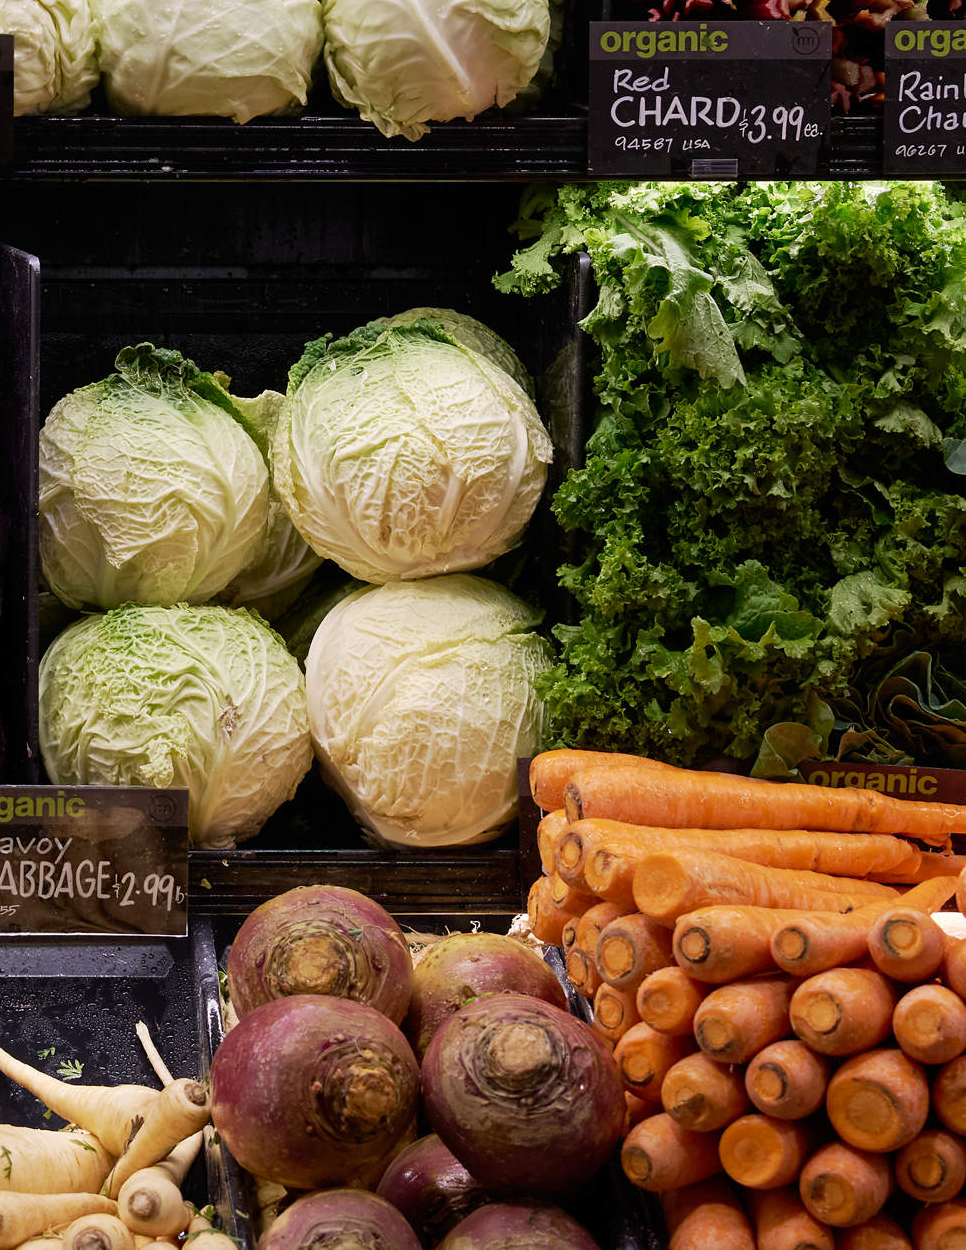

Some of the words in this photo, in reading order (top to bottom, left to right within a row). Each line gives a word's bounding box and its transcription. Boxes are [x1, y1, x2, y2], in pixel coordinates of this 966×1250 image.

[600, 24, 728, 58] organic
[613, 67, 670, 93] Red
[898, 71, 966, 101] Rain
[610, 96, 741, 127] CHARD
[738, 105, 804, 143] $3.99
[614, 136, 673, 153] 94587
[683, 139, 710, 150] USA
[808, 768, 938, 795] organic
[112, 872, 174, 911] $2.99
